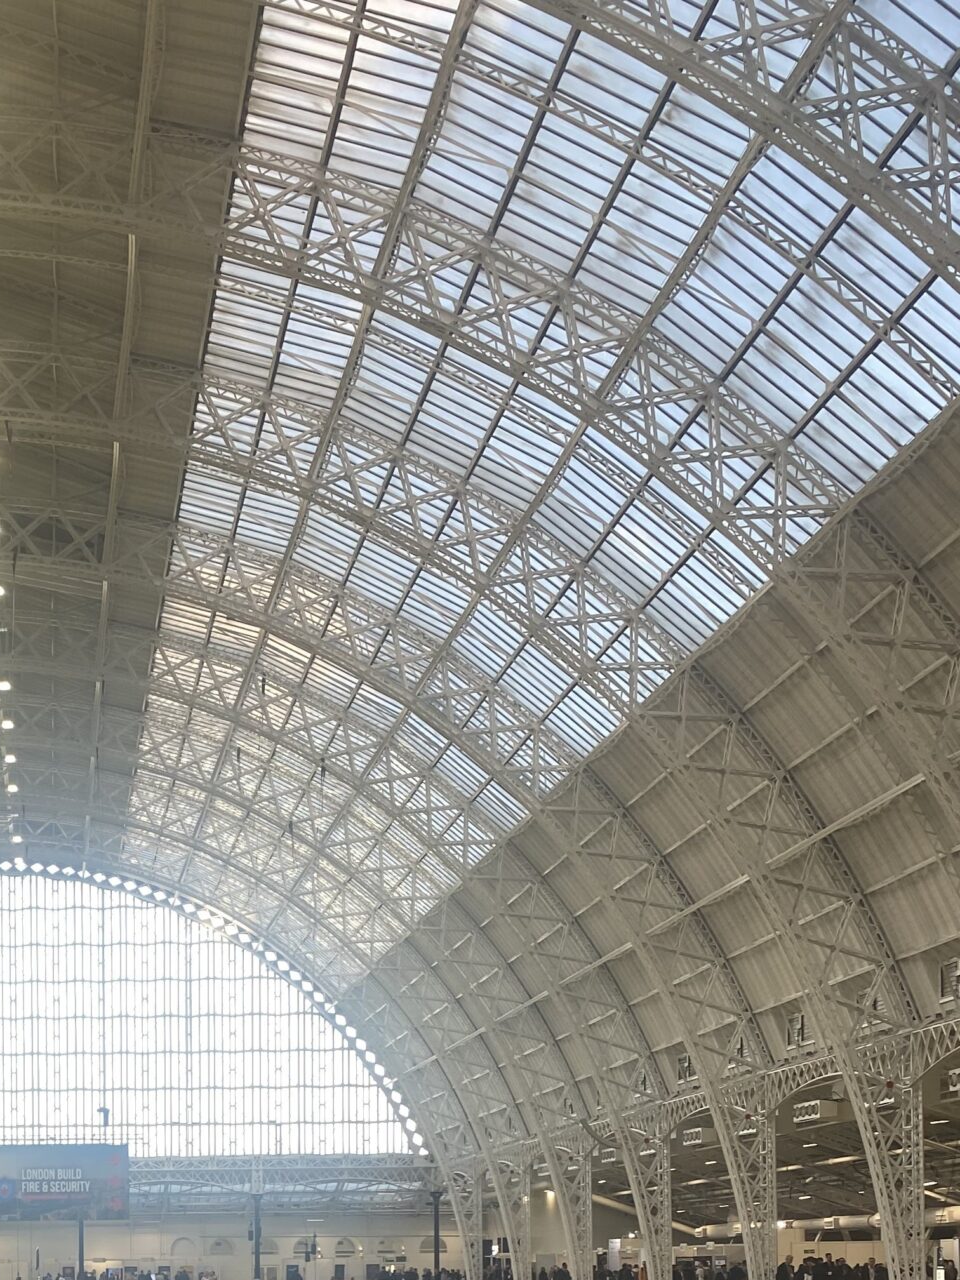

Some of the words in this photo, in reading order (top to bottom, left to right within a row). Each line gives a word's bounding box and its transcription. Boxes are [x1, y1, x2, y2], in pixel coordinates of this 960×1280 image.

[21, 1168, 56, 1180] LONDON
[57, 1168, 82, 1180] BUILD
[21, 1181, 40, 1192] FIRE
[42, 1181, 48, 1192] &
[50, 1181, 90, 1192] SECURITY
